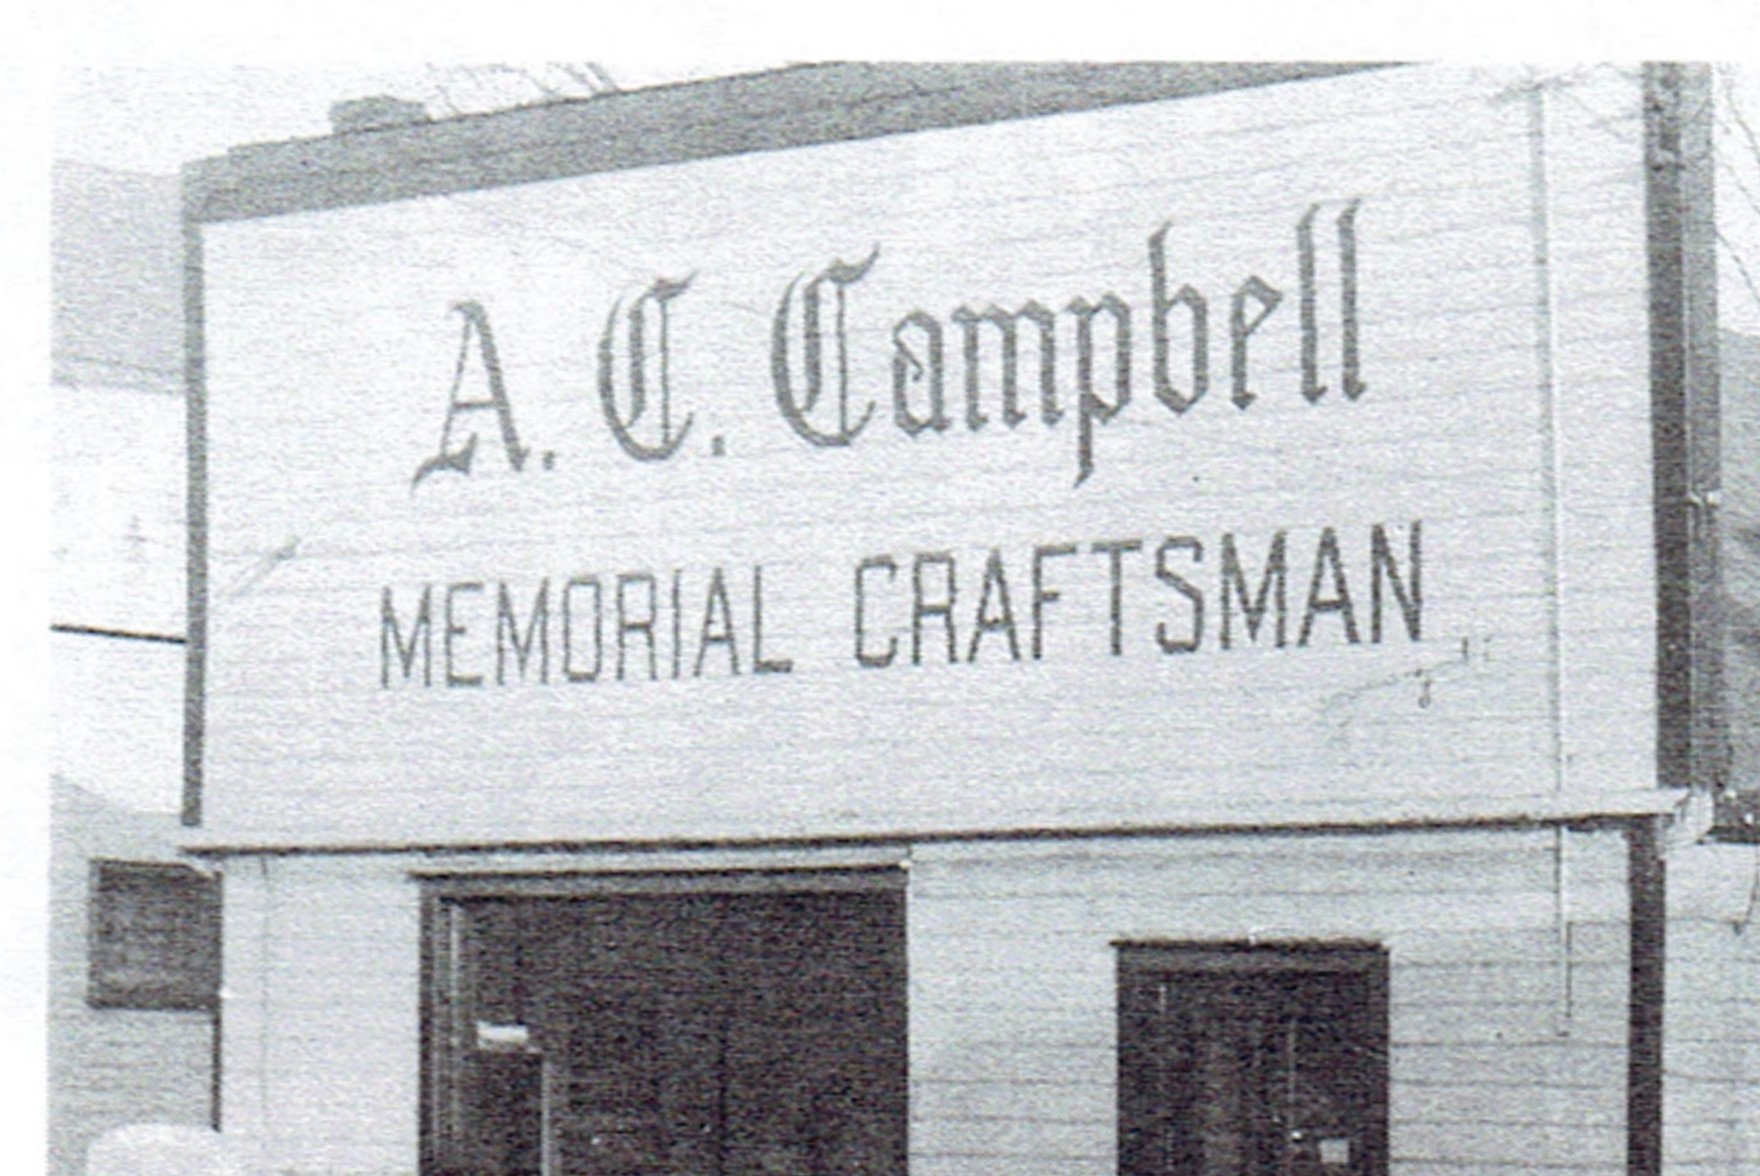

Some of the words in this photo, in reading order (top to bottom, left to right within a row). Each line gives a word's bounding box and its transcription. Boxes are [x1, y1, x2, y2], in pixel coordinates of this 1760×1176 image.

[411, 300, 555, 490] A.
[598, 272, 724, 461] C.
[771, 199, 1366, 488] Campbell
[380, 563, 793, 688] MEMORIAL
[853, 521, 1422, 667] CRAFTSMAN
